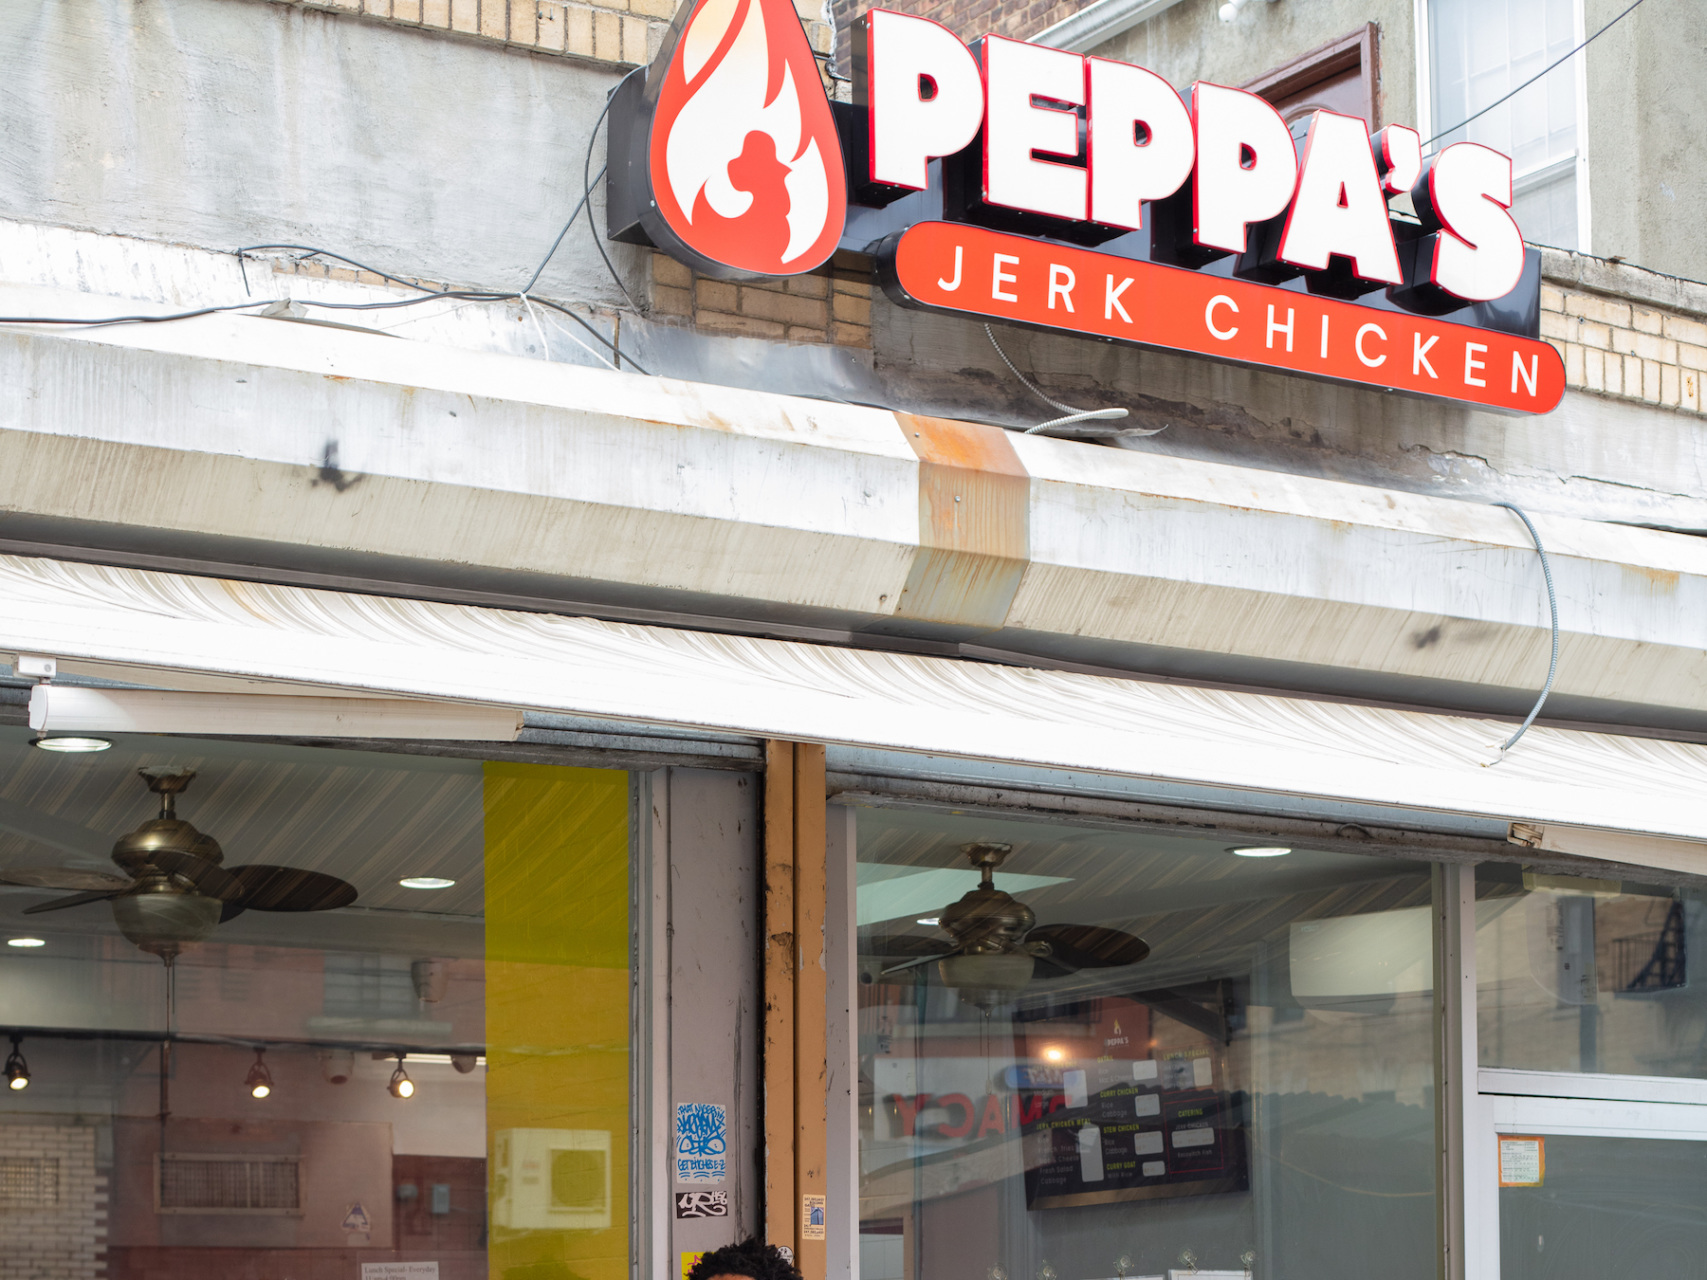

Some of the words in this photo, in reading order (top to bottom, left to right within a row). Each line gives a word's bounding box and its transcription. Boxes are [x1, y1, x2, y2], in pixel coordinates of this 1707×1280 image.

[869, 8, 1524, 302] PEPPA'S
[937, 245, 1134, 324] JERK
[1205, 295, 1541, 398] CHICKEN
[409, 1266, 435, 1275] Everyday
